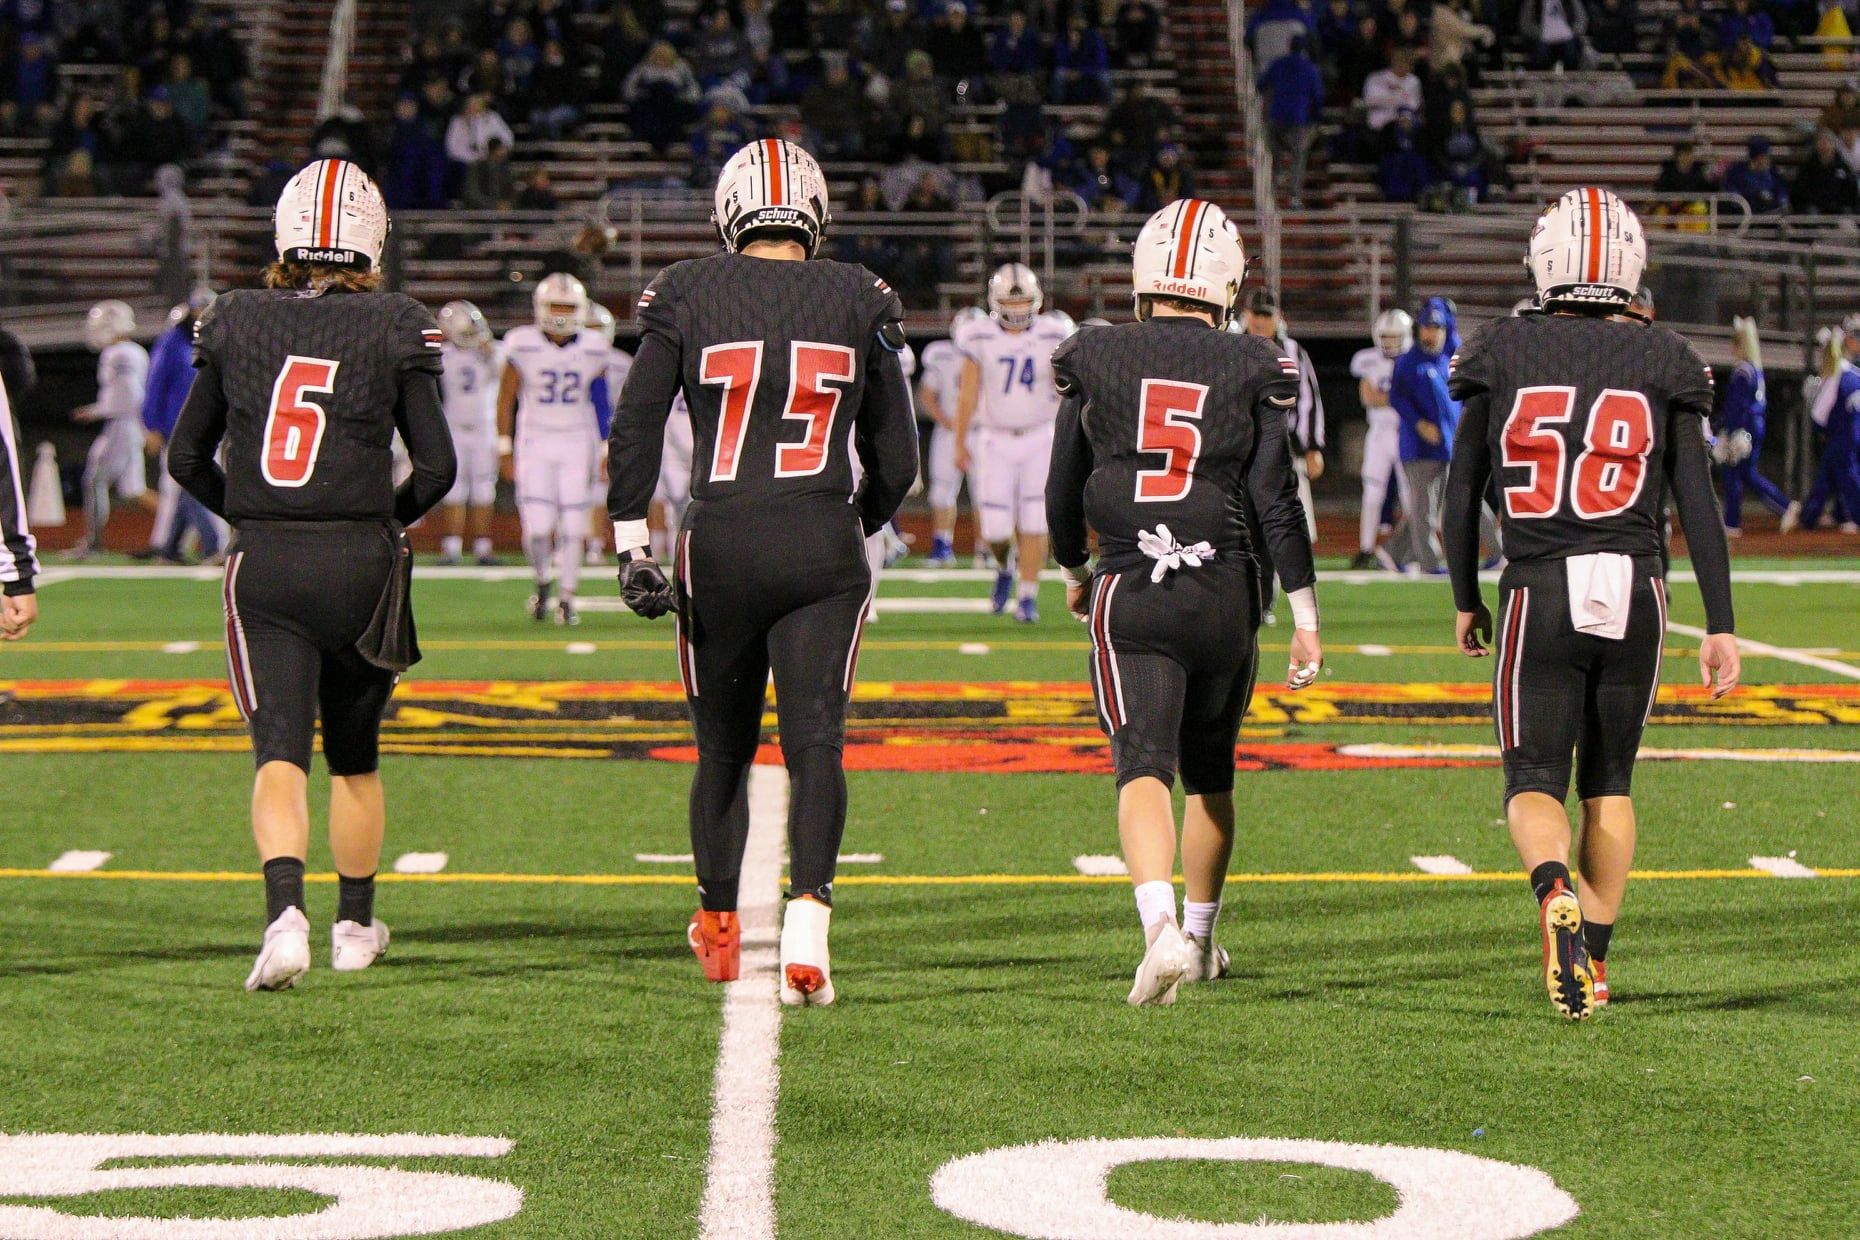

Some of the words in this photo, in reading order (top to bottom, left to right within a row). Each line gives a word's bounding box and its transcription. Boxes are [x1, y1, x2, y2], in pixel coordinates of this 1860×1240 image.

[348, 191, 356, 202] 6
[297, 248, 355, 264] Riddell
[1153, 280, 1207, 299] Riddell
[538, 371, 580, 404] 32
[998, 357, 1035, 394] 74
[261, 355, 341, 487] 6
[700, 340, 855, 482] 75
[1134, 378, 1210, 503] 5
[1500, 385, 1653, 519] 58
